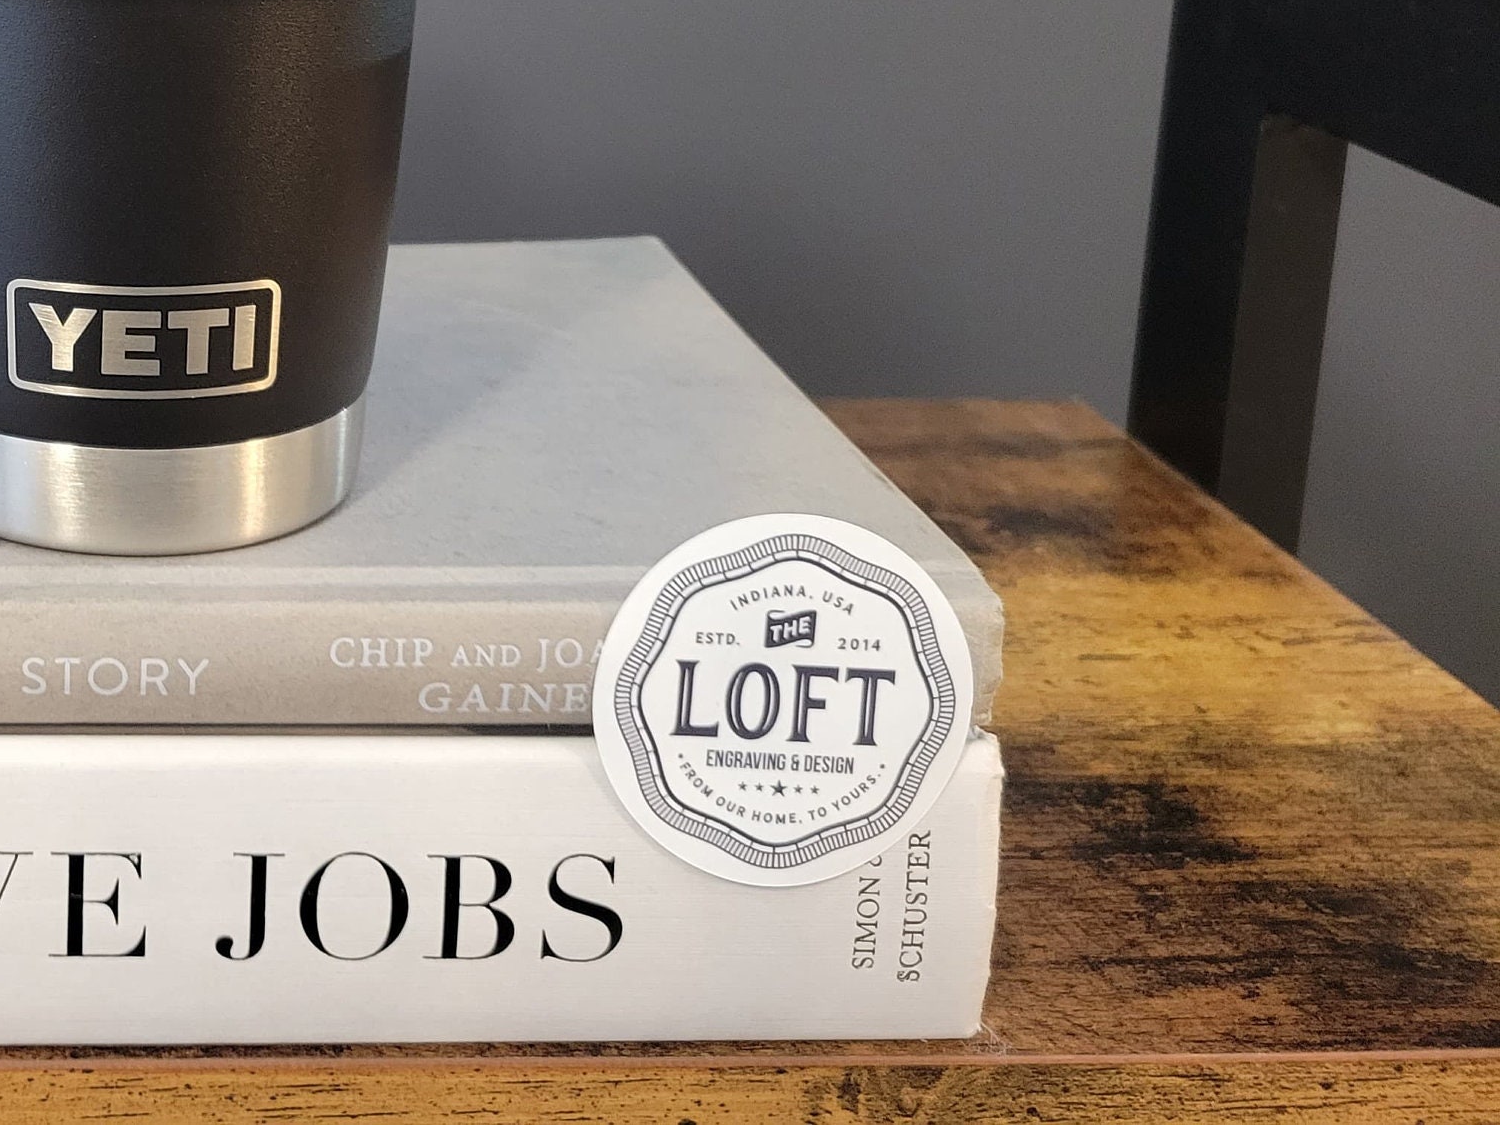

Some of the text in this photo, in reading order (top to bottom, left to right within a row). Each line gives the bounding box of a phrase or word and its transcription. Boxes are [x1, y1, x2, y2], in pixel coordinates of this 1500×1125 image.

[28, 302, 256, 378] YETI
[822, 591, 854, 616] USA
[329, 637, 433, 668] CHIP
[450, 644, 521, 668] AND
[696, 632, 881, 652] ESTD. 2014
[770, 616, 812, 643] THE
[21, 657, 211, 696] STORY
[669, 659, 896, 747] LOFT
[706, 749, 854, 774] ENGRAVING & DESIGN
[680, 762, 713, 798] FROM
[715, 796, 747, 818] OUR
[808, 806, 828, 821] TO
[215, 850, 624, 962] JOBS
[852, 877, 881, 969] SIMON
[897, 830, 931, 982] SCHUSTER
